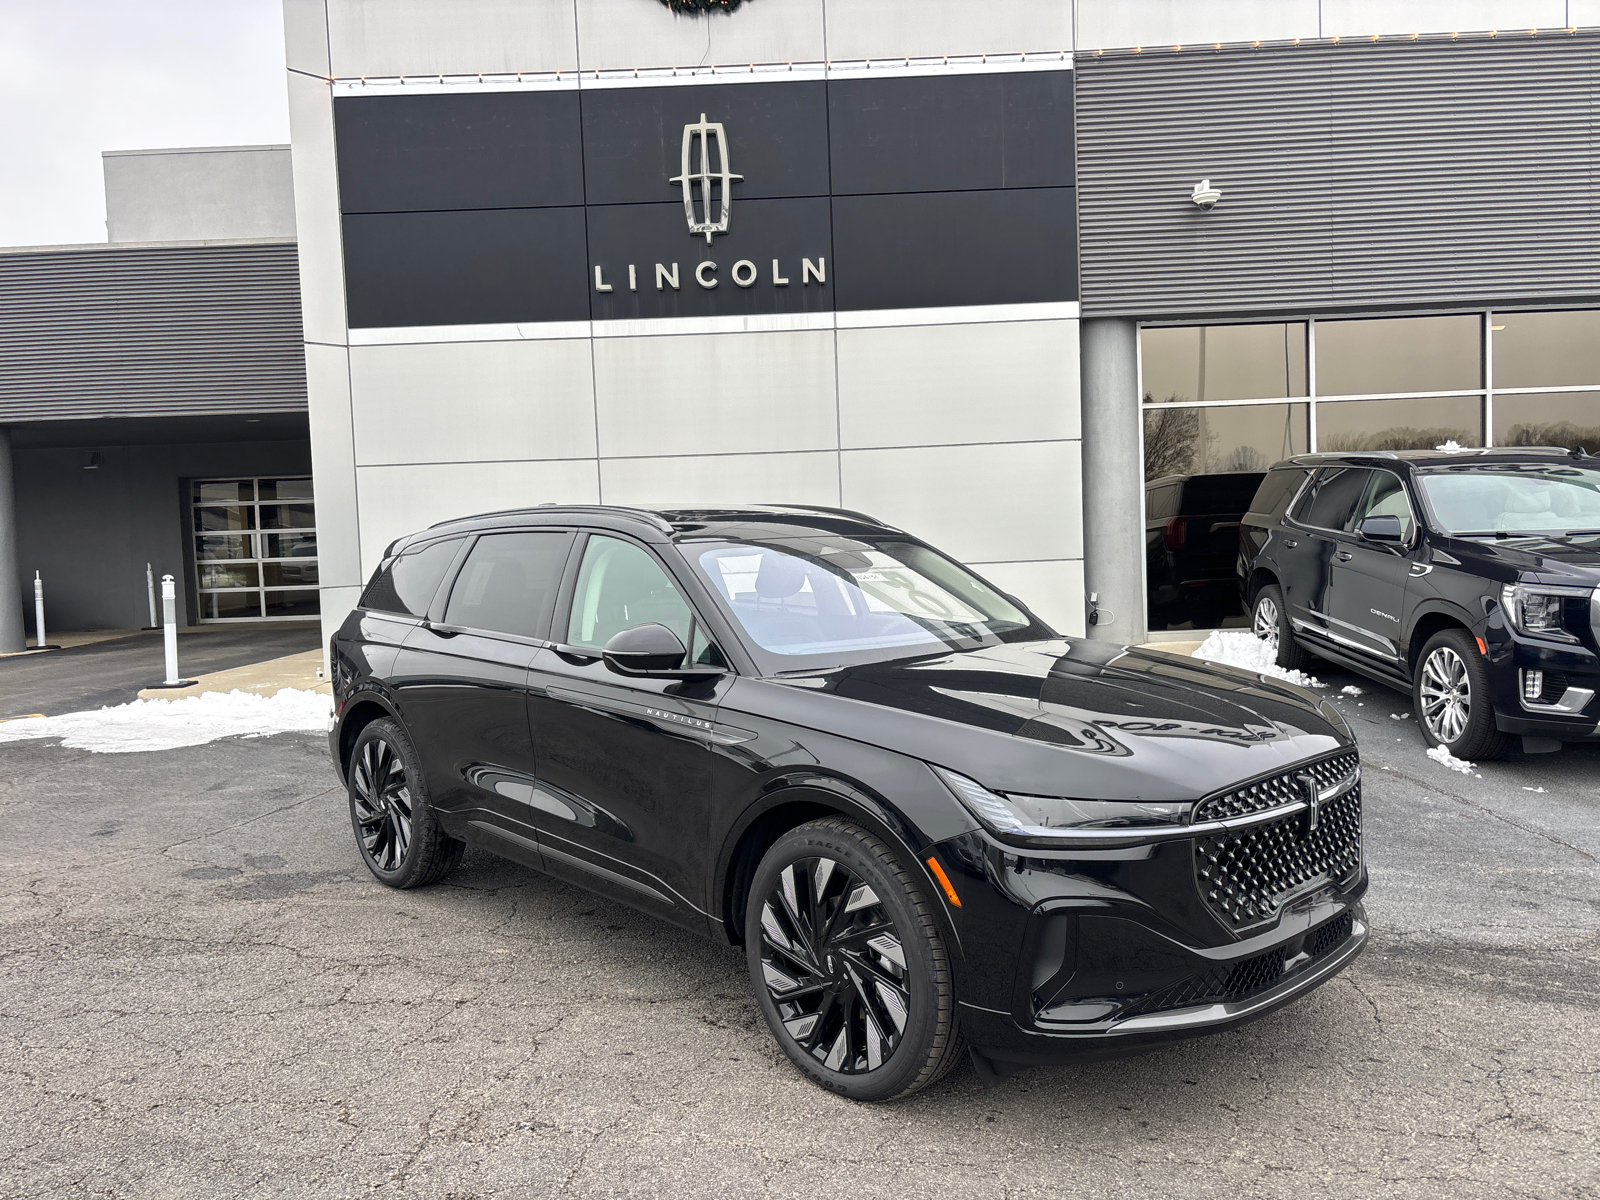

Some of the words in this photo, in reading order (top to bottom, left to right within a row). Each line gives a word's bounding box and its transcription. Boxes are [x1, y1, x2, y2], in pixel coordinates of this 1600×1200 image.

[594, 257, 826, 292] LINCOLN
[1370, 608, 1400, 623] DENALI
[646, 708, 710, 729] NAUTILUS
[807, 839, 853, 858] EAGLE
